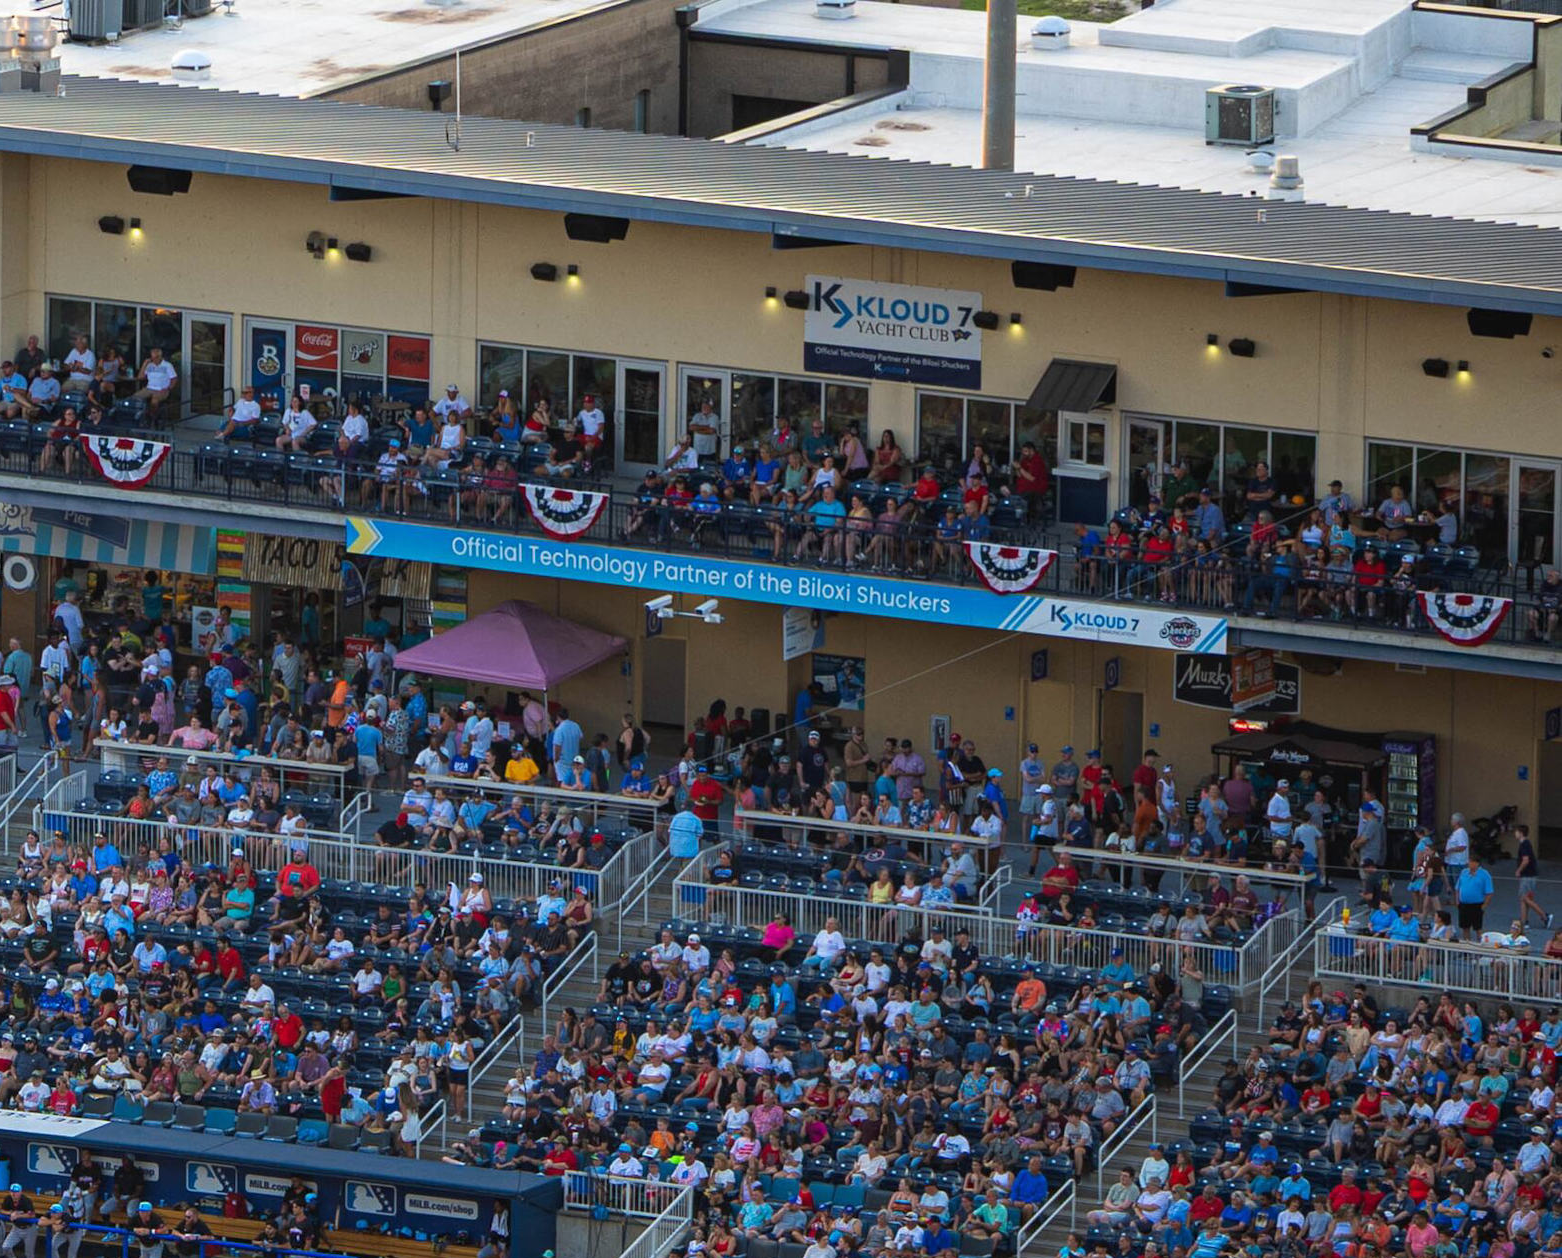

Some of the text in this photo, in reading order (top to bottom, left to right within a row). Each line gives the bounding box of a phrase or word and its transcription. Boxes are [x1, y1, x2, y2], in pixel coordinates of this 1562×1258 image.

[856, 295, 973, 327] KLOUD 7
[856, 320, 950, 342] YACHT CLUB
[815, 346, 839, 355] Official
[840, 347, 876, 362] Technology
[877, 353, 902, 364] Partner
[263, 534, 319, 570] TACO
[451, 536, 1140, 631] Official Technology Partner of the Biloxi Shuckers KLOUD 7
[1178, 658, 1233, 695] Murky
[408, 1198, 474, 1216] MiLB.com/shop
